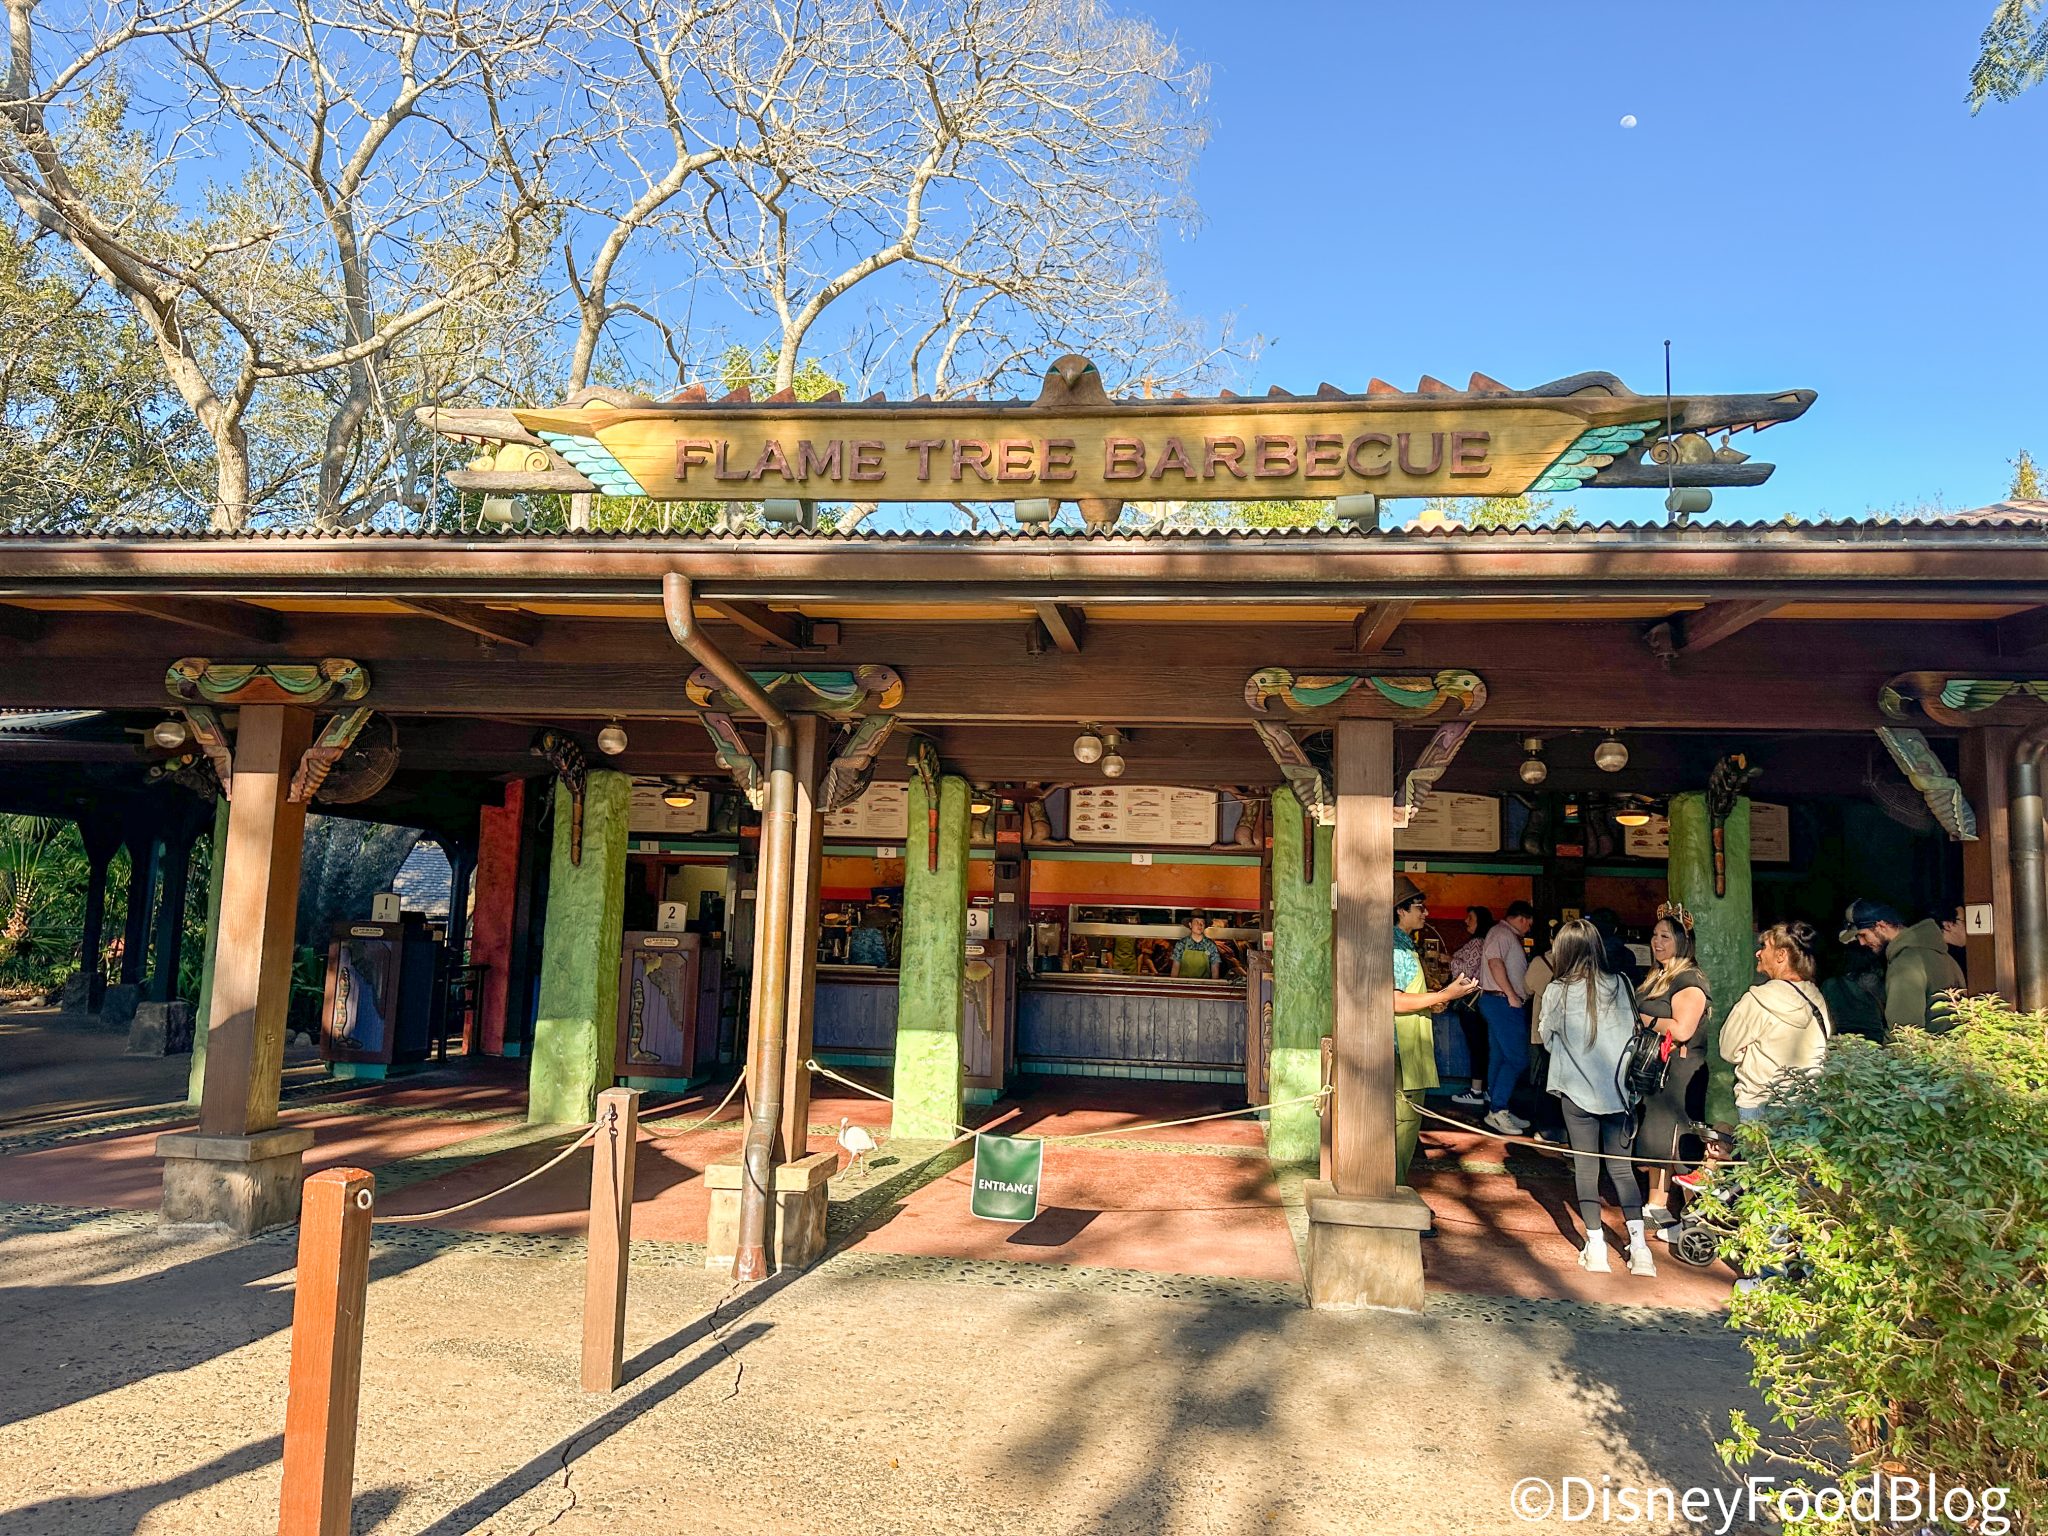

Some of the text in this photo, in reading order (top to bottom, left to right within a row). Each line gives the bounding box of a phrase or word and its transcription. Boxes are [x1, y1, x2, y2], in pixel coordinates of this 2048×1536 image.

[674, 431, 1492, 482] FLAME TREE BARBECUE
[884, 847, 890, 856] 2
[1139, 854, 1145, 863] 3
[1412, 862, 1418, 871] 4
[384, 897, 389, 910] 1
[668, 906, 676, 919] 2
[1975, 910, 1982, 928] 4
[969, 913, 977, 926] 3
[978, 1178, 1034, 1195] ENTRANCE
